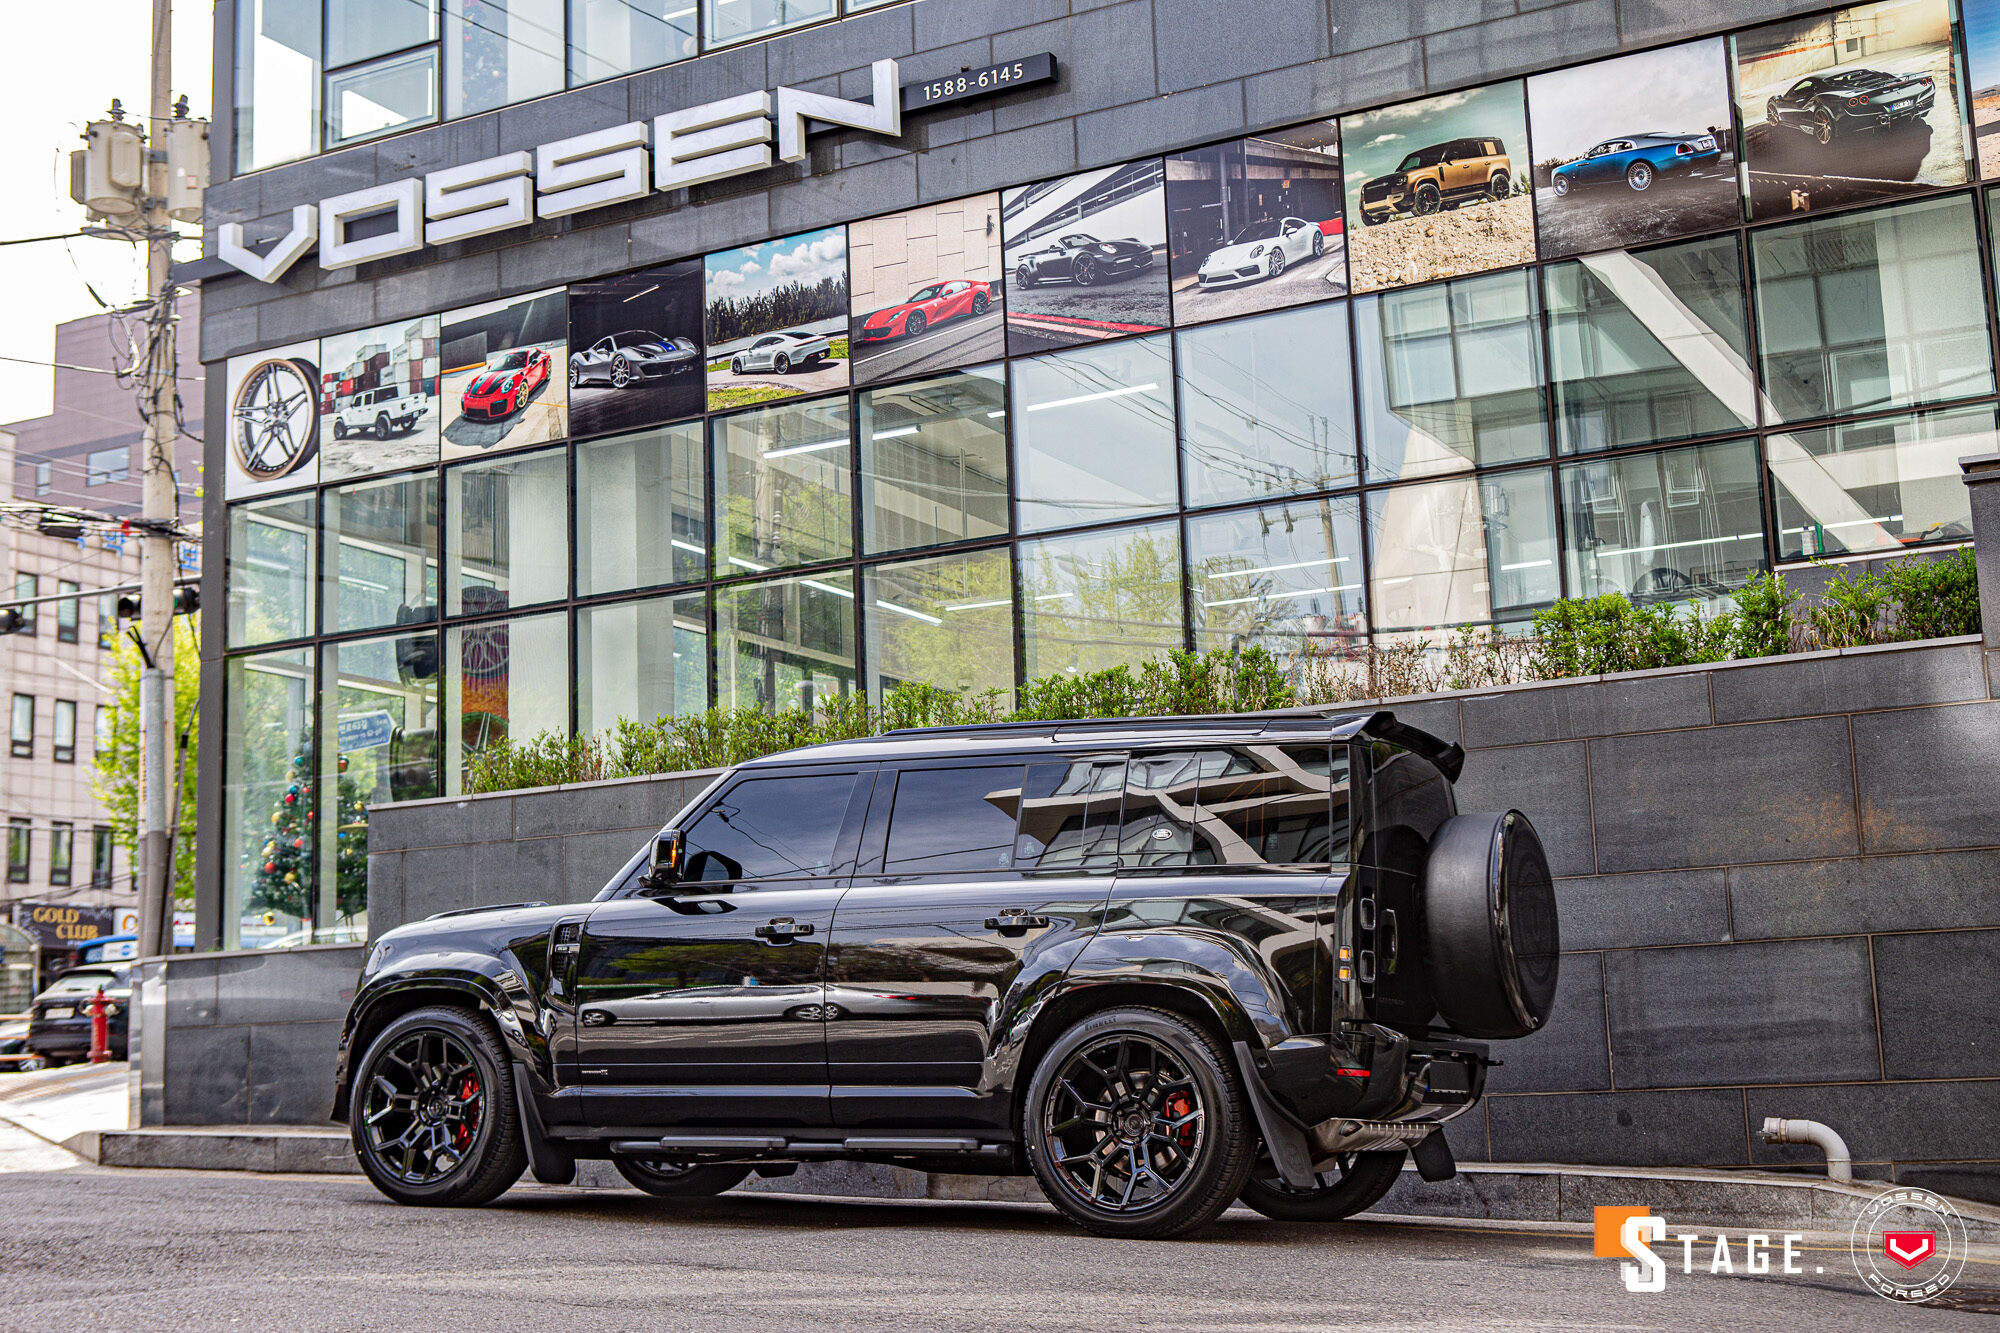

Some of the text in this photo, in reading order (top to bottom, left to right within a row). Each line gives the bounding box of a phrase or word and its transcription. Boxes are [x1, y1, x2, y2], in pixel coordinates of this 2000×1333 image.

[923, 63, 1024, 101] 1588-6145
[218, 58, 901, 283] VOSSEN
[33, 907, 79, 924] GOLD
[56, 924, 99, 940] CLUB
